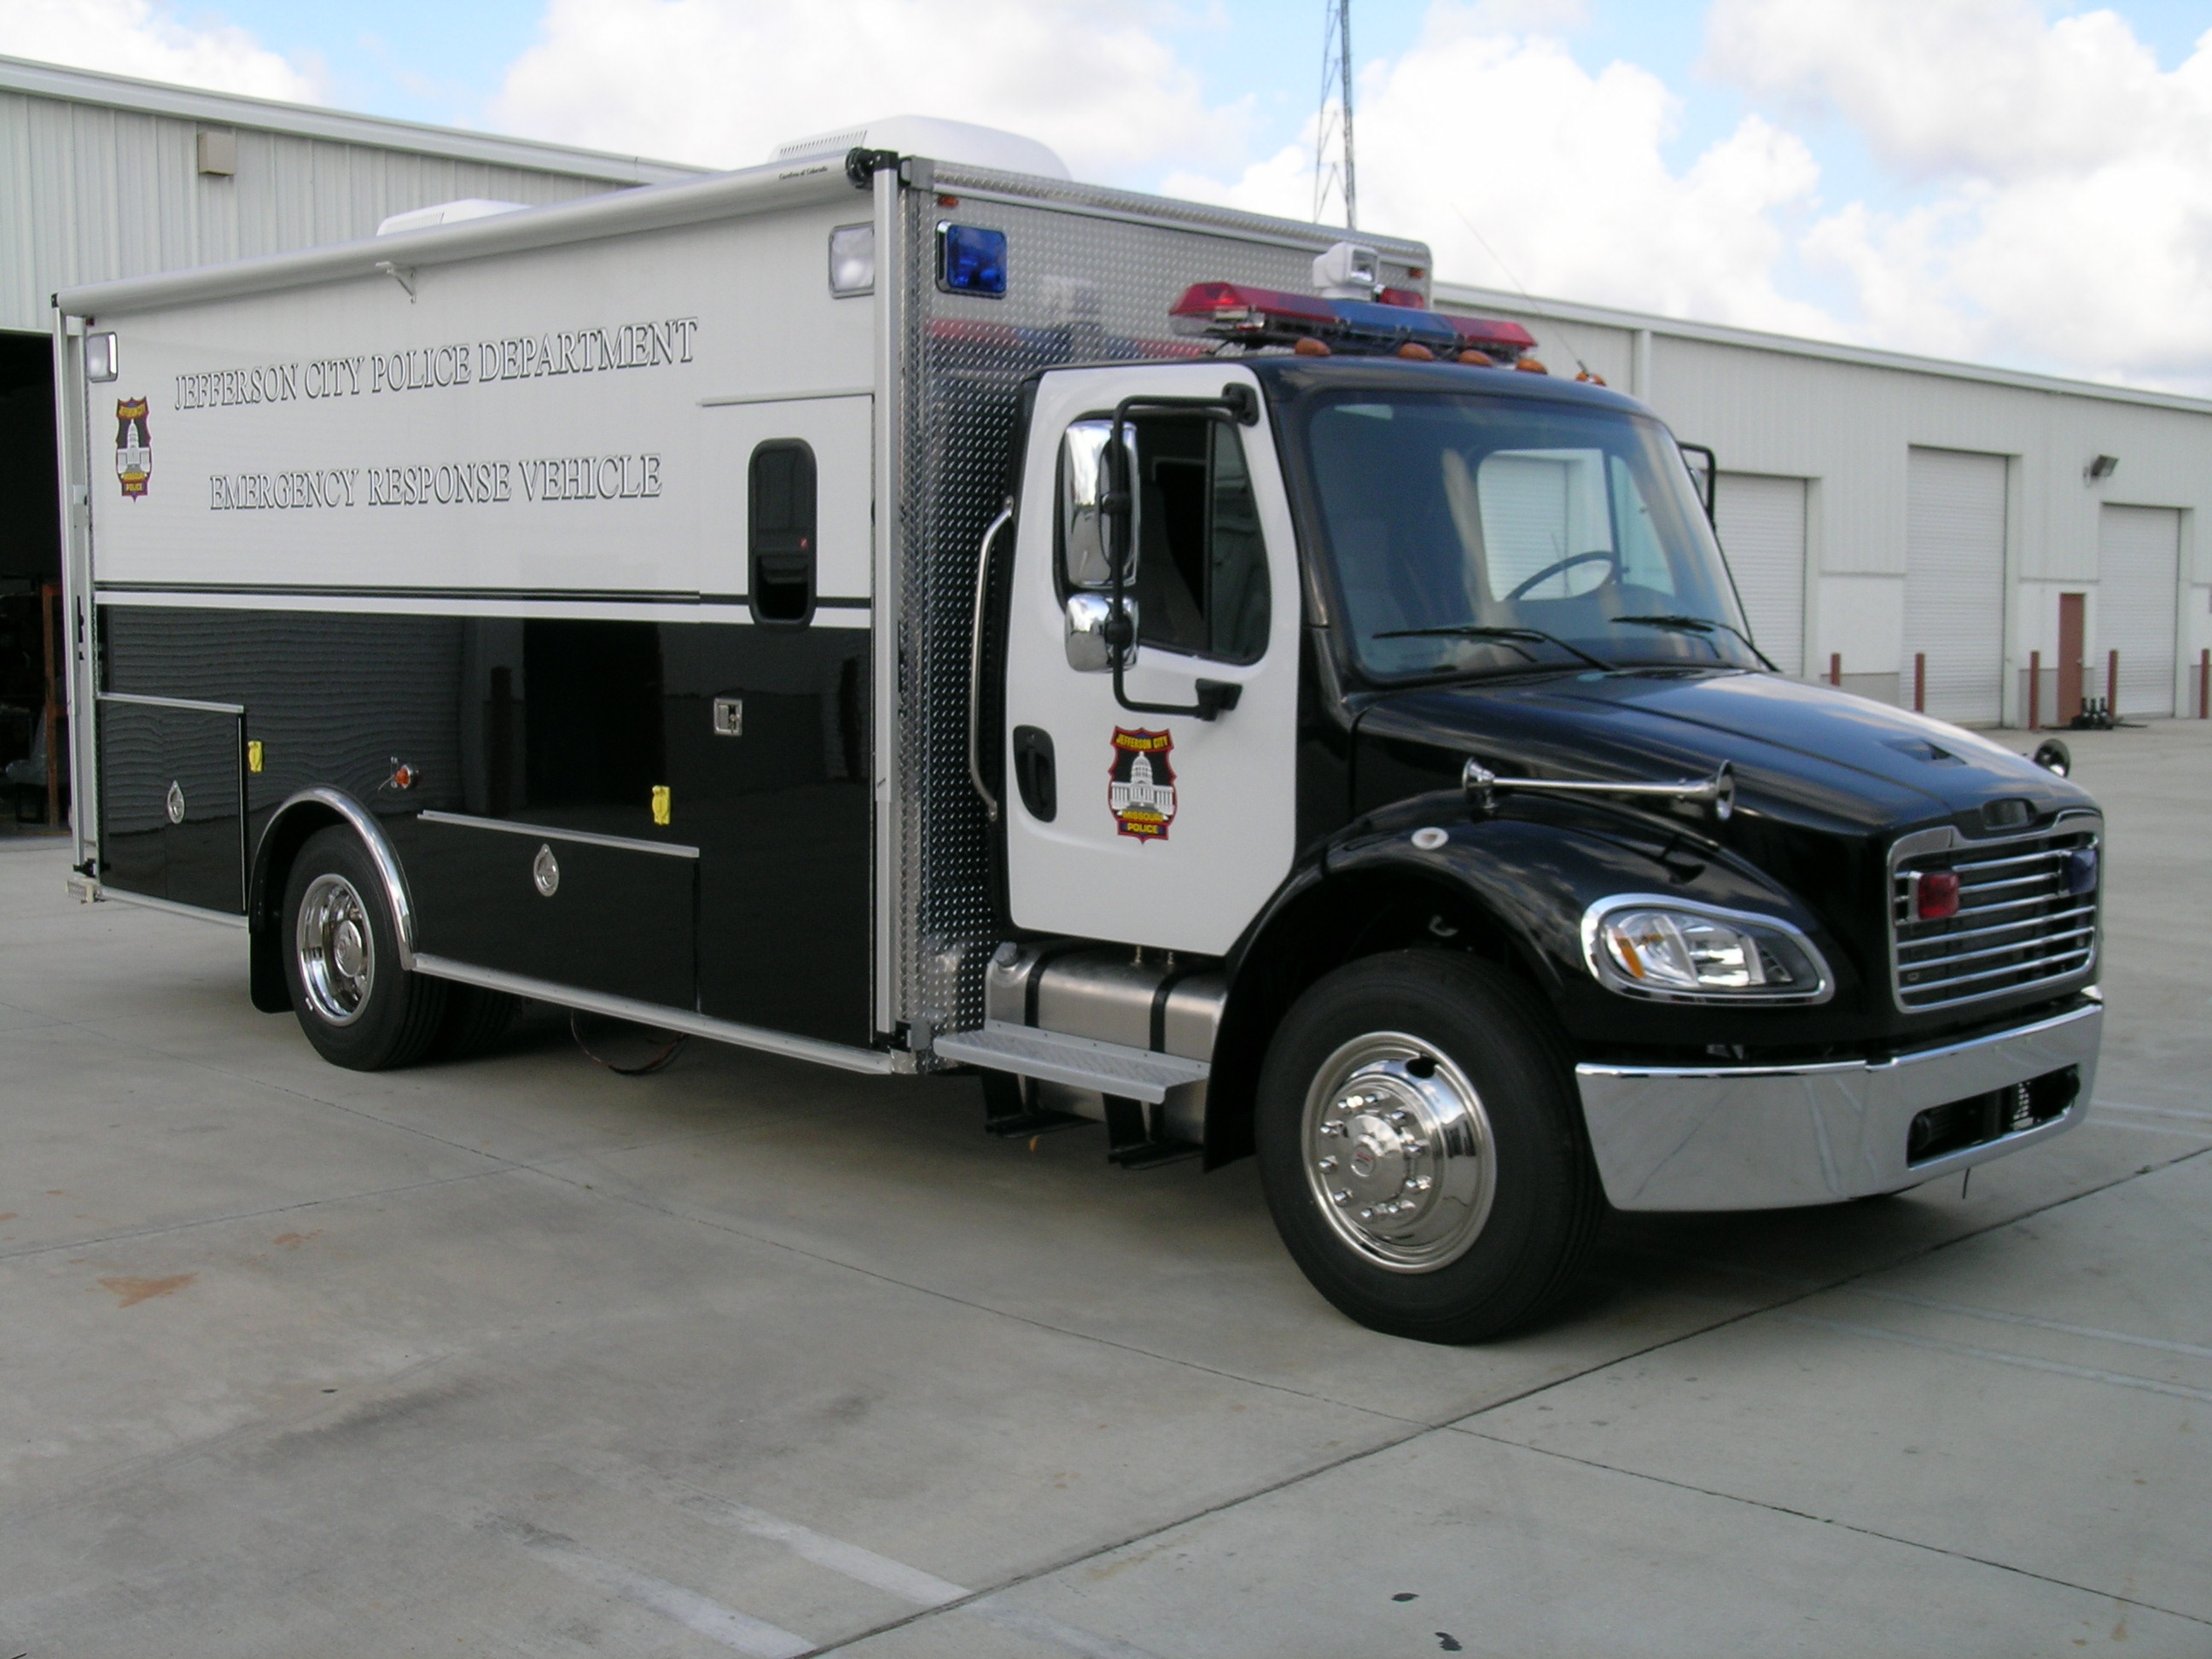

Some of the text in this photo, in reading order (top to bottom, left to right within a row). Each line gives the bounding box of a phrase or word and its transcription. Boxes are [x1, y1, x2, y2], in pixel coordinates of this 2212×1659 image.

[174, 317, 698, 410] JEFFERSON CITY POLICE DEPARTMENT
[210, 452, 662, 510] EMERGENCY RESPONSE VEHICLE
[1115, 733, 1168, 749] JEFFERSON CITY
[1127, 823, 1159, 834] POLICE
